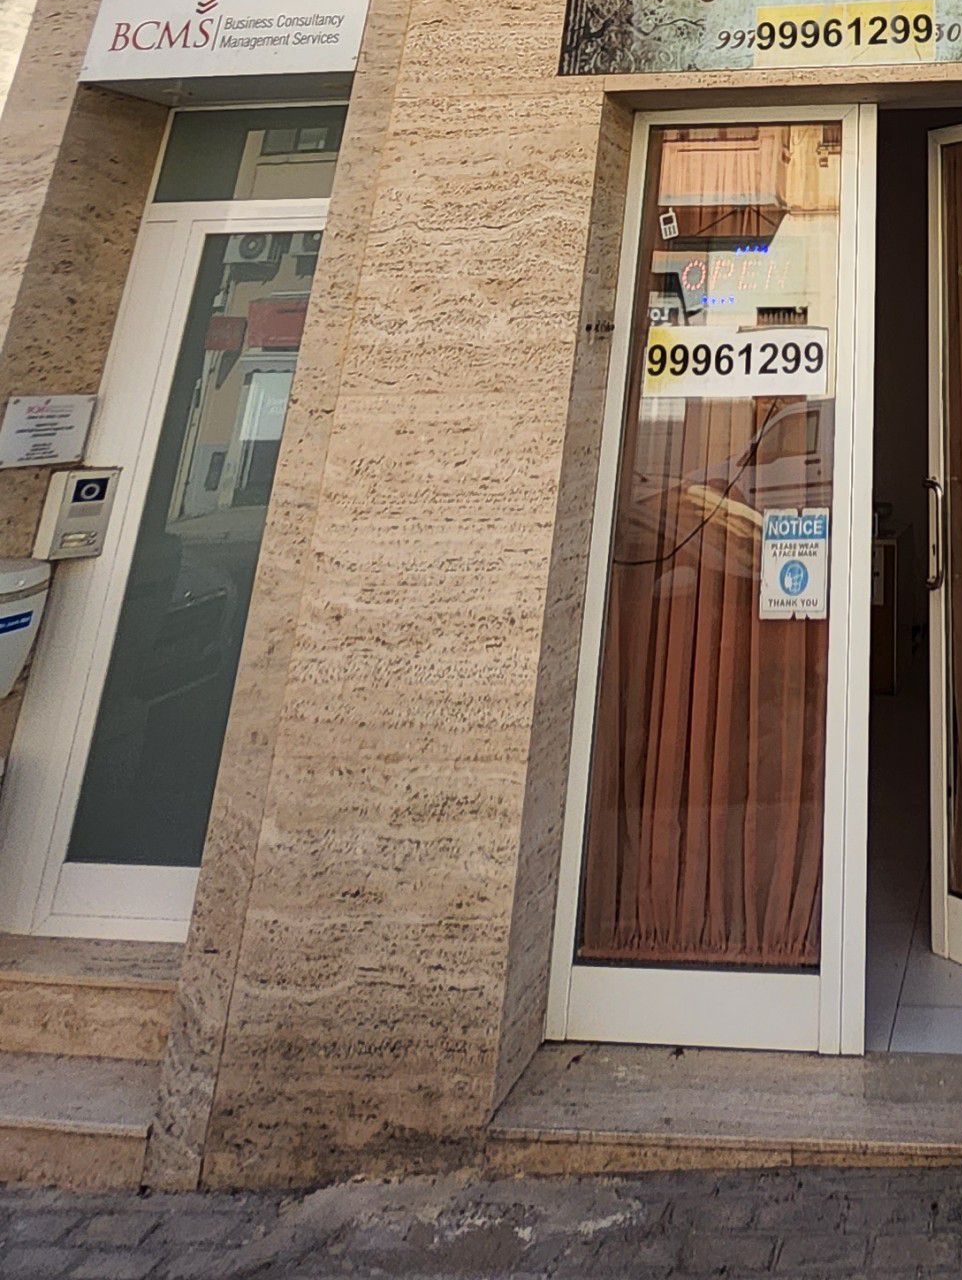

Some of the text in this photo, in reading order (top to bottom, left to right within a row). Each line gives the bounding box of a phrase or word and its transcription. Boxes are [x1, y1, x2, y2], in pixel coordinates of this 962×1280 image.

[224, 14, 345, 30] Business Consultancy
[108, 18, 214, 52] BCMS
[756, 12, 933, 51] 99961299
[220, 31, 340, 51] Management Services
[681, 259, 792, 292] OPEN
[647, 341, 824, 377] 99961299
[768, 520, 823, 536] NOTICE
[798, 549, 818, 557] MASK
[799, 542, 819, 550] WEAR
[768, 598, 818, 608] THANK YOU
